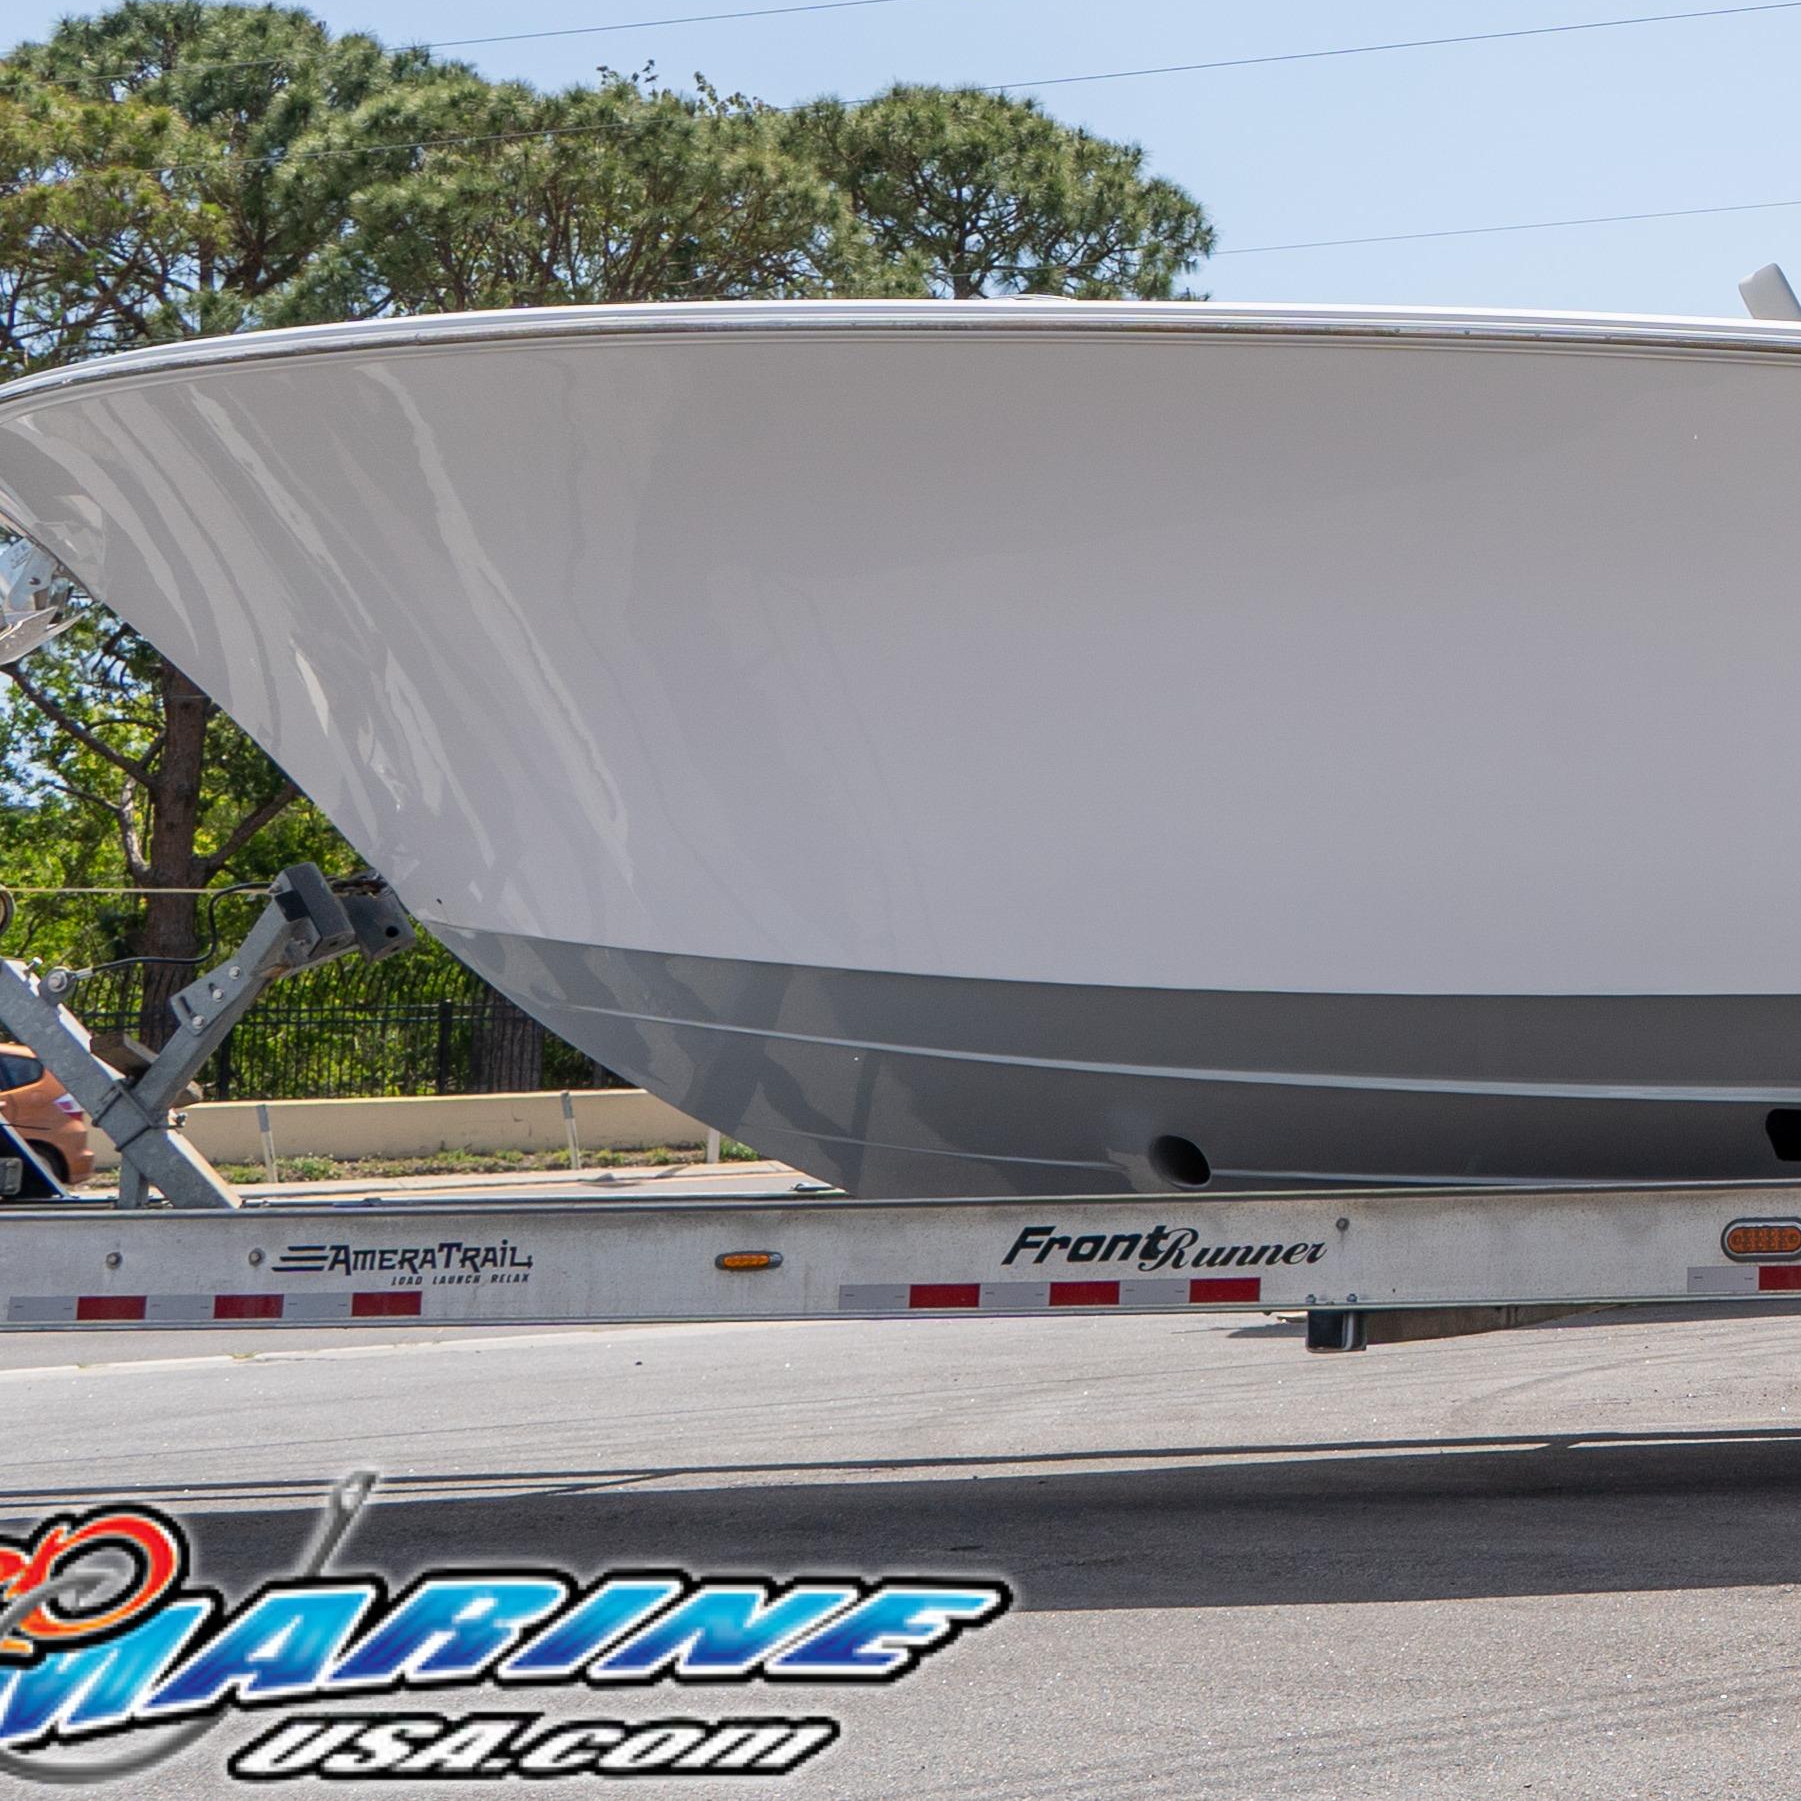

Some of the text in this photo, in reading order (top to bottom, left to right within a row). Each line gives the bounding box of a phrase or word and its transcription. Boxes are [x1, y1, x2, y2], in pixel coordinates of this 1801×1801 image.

[391, 1273, 530, 1287] LOAD LAUNCH RELAX
